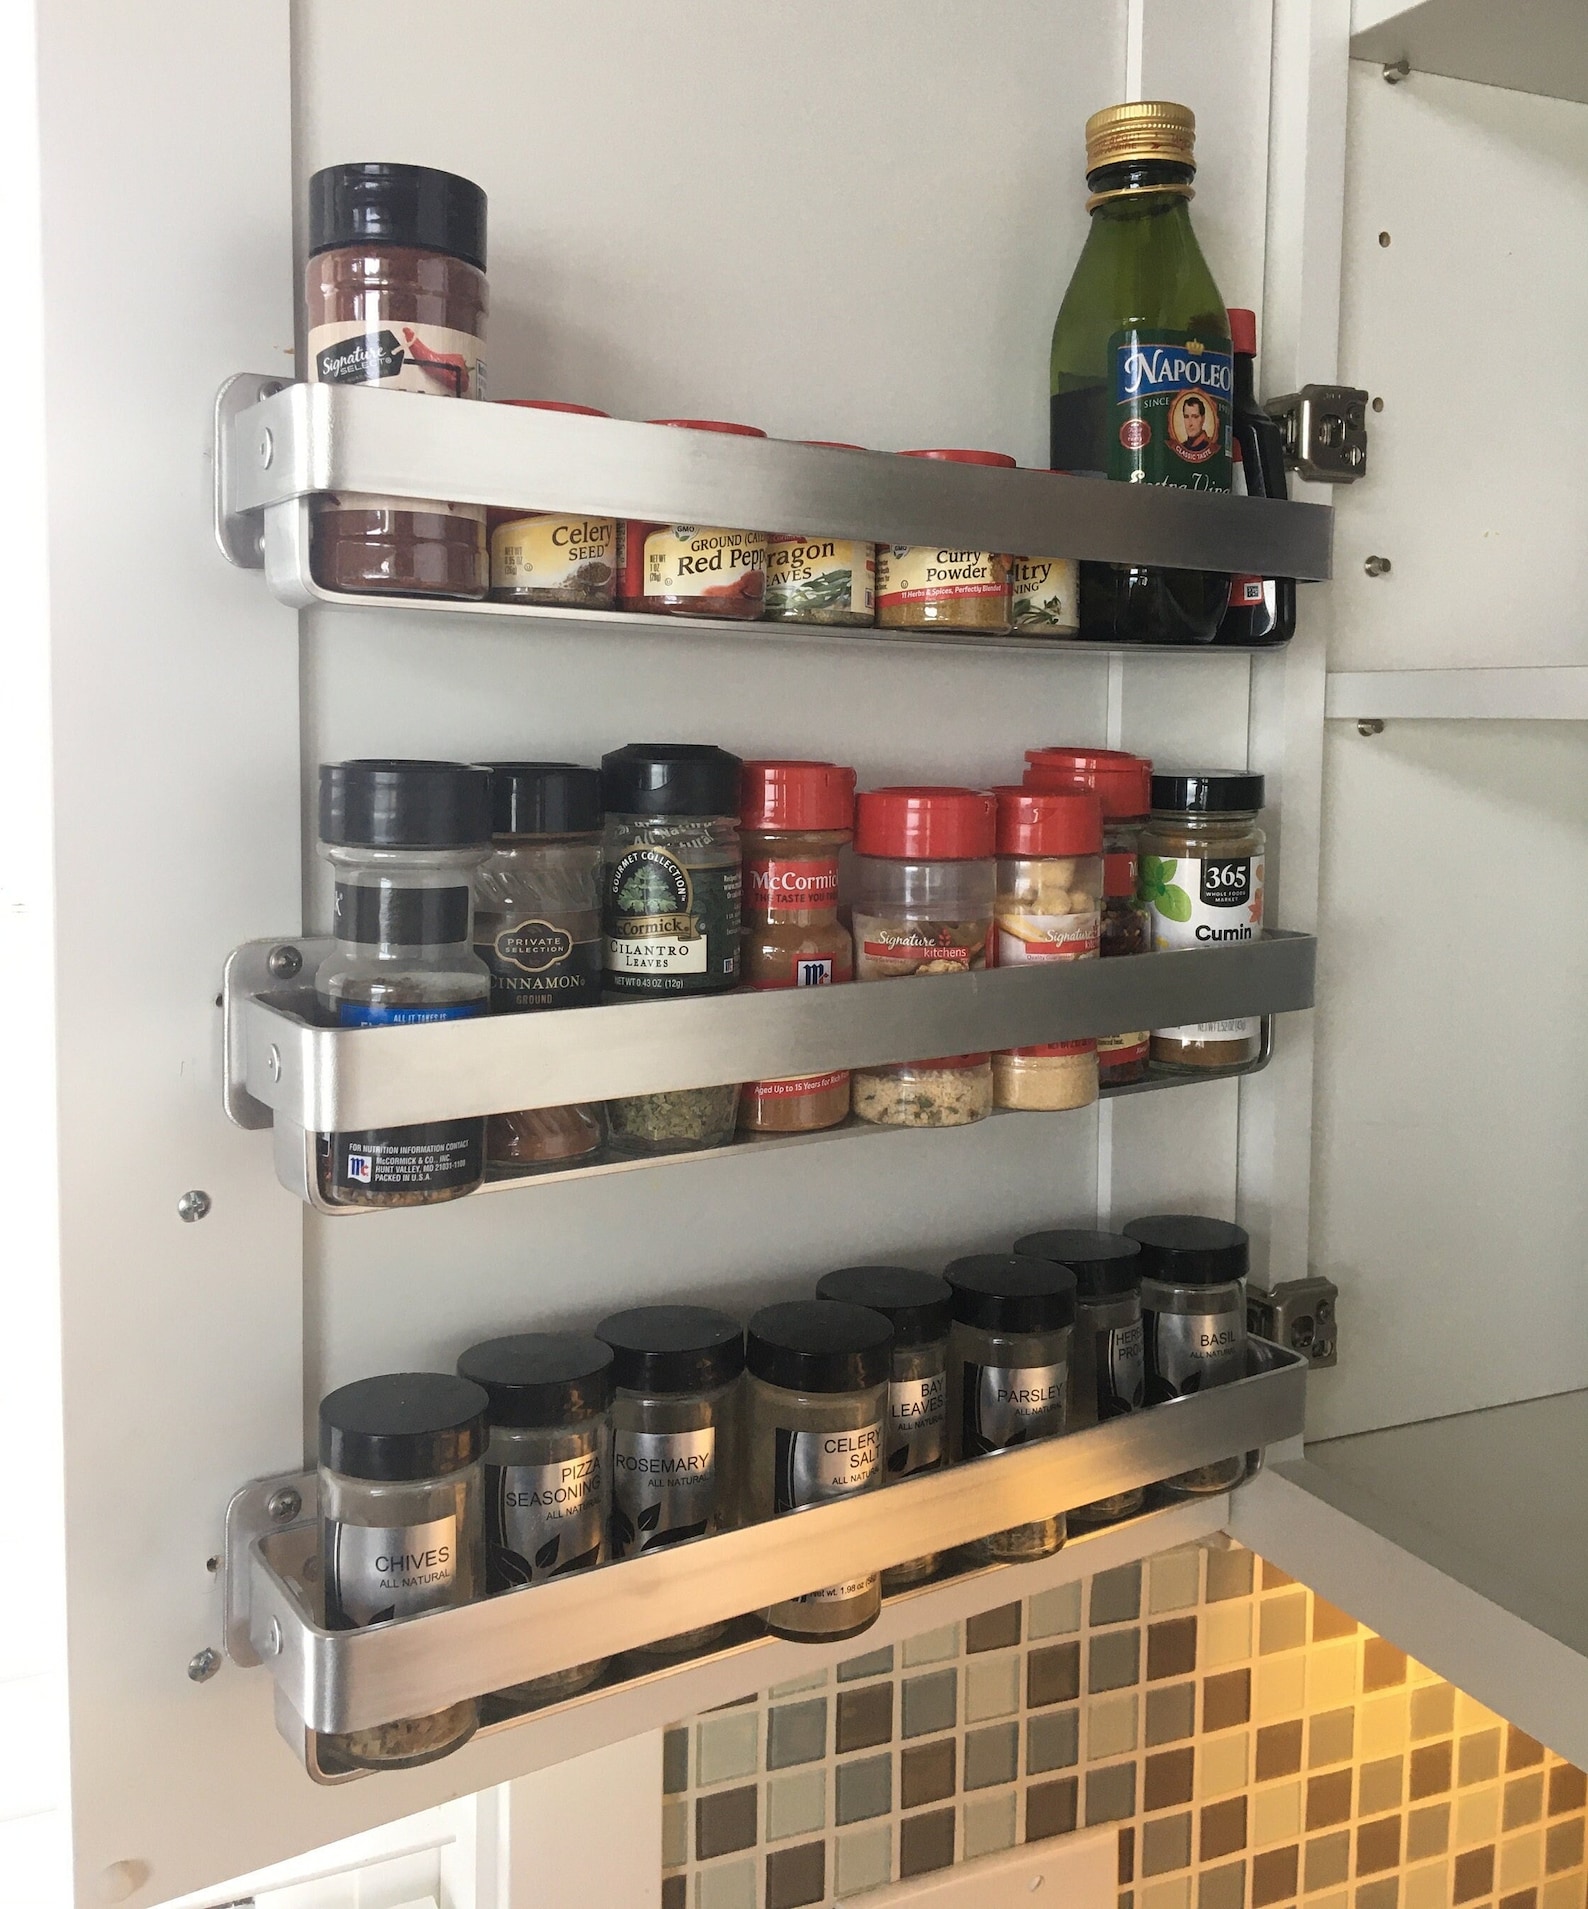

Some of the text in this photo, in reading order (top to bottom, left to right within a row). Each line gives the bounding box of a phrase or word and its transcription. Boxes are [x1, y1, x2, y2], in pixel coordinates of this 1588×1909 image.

[322, 346, 387, 377] Signature
[340, 357, 385, 376] SELECT
[1144, 397, 1169, 408] SINCE
[1175, 445, 1212, 461] CLASSIC TASTE
[552, 521, 613, 548] Celery
[676, 525, 695, 533] GMO
[691, 534, 742, 552] GROUND
[568, 544, 605, 561] SEED
[936, 550, 982, 567] Curry
[677, 550, 722, 577] Red
[926, 566, 988, 582] Powder
[901, 584, 1002, 599] 11 Herbs & Spices, Perfectly Blended
[612, 852, 639, 894] GOURMET
[641, 851, 688, 895] COLLECTION
[1206, 863, 1247, 889] 365
[776, 893, 805, 903] TASTE
[808, 893, 826, 902] YOU
[879, 930, 936, 950] Signature
[1195, 923, 1251, 942] Cumin
[507, 937, 561, 946] PRIVATE
[610, 940, 689, 957] CILANTRO
[505, 946, 564, 954] SELECTION
[923, 947, 967, 958] kitchens
[626, 955, 669, 968] LEAVES
[614, 976, 684, 989] NET WT 0.43 OZ (12g)
[516, 994, 553, 1004] GROUND
[393, 1014, 406, 1023] ALL
[754, 1085, 773, 1096] Aged
[774, 1085, 785, 1094] Up
[786, 1084, 793, 1092] to
[795, 1083, 803, 1091] 15
[803, 1080, 821, 1090] Years
[821, 1078, 830, 1087] for
[349, 1139, 470, 1154] FOR NUTRITION INFORMATION CONTACT
[376, 1156, 416, 1165] McCORMICK
[417, 1156, 423, 1164] &
[375, 1165, 394, 1174] HUNT
[395, 1164, 422, 1174] VALLEY,
[423, 1164, 434, 1173] MD
[375, 1173, 401, 1182] PACKED
[402, 1173, 410, 1182] IN
[1200, 1330, 1237, 1347] BASIL
[1190, 1351, 1204, 1359] ALL
[921, 1379, 945, 1398] BAY
[997, 1383, 1064, 1403] PARSLEY
[892, 1394, 944, 1418] LEAVES
[1015, 1407, 1031, 1416] ALL
[897, 1422, 913, 1431] ALL
[824, 1426, 882, 1454] CELERY
[616, 1453, 709, 1474] ROSEMARY
[849, 1444, 882, 1469] SALT
[562, 1458, 601, 1483] PIZZA
[647, 1475, 709, 1488] ALL NATURAL
[832, 1476, 848, 1485] ALL
[505, 1476, 601, 1507] SEASONING
[545, 1510, 564, 1521] ALL
[375, 1546, 450, 1572] CHIVES
[379, 1568, 450, 1589] ALL NATURAL
[826, 1588, 838, 1597] wt.
[840, 1584, 856, 1595] 1.98
[856, 1582, 865, 1590] oz
